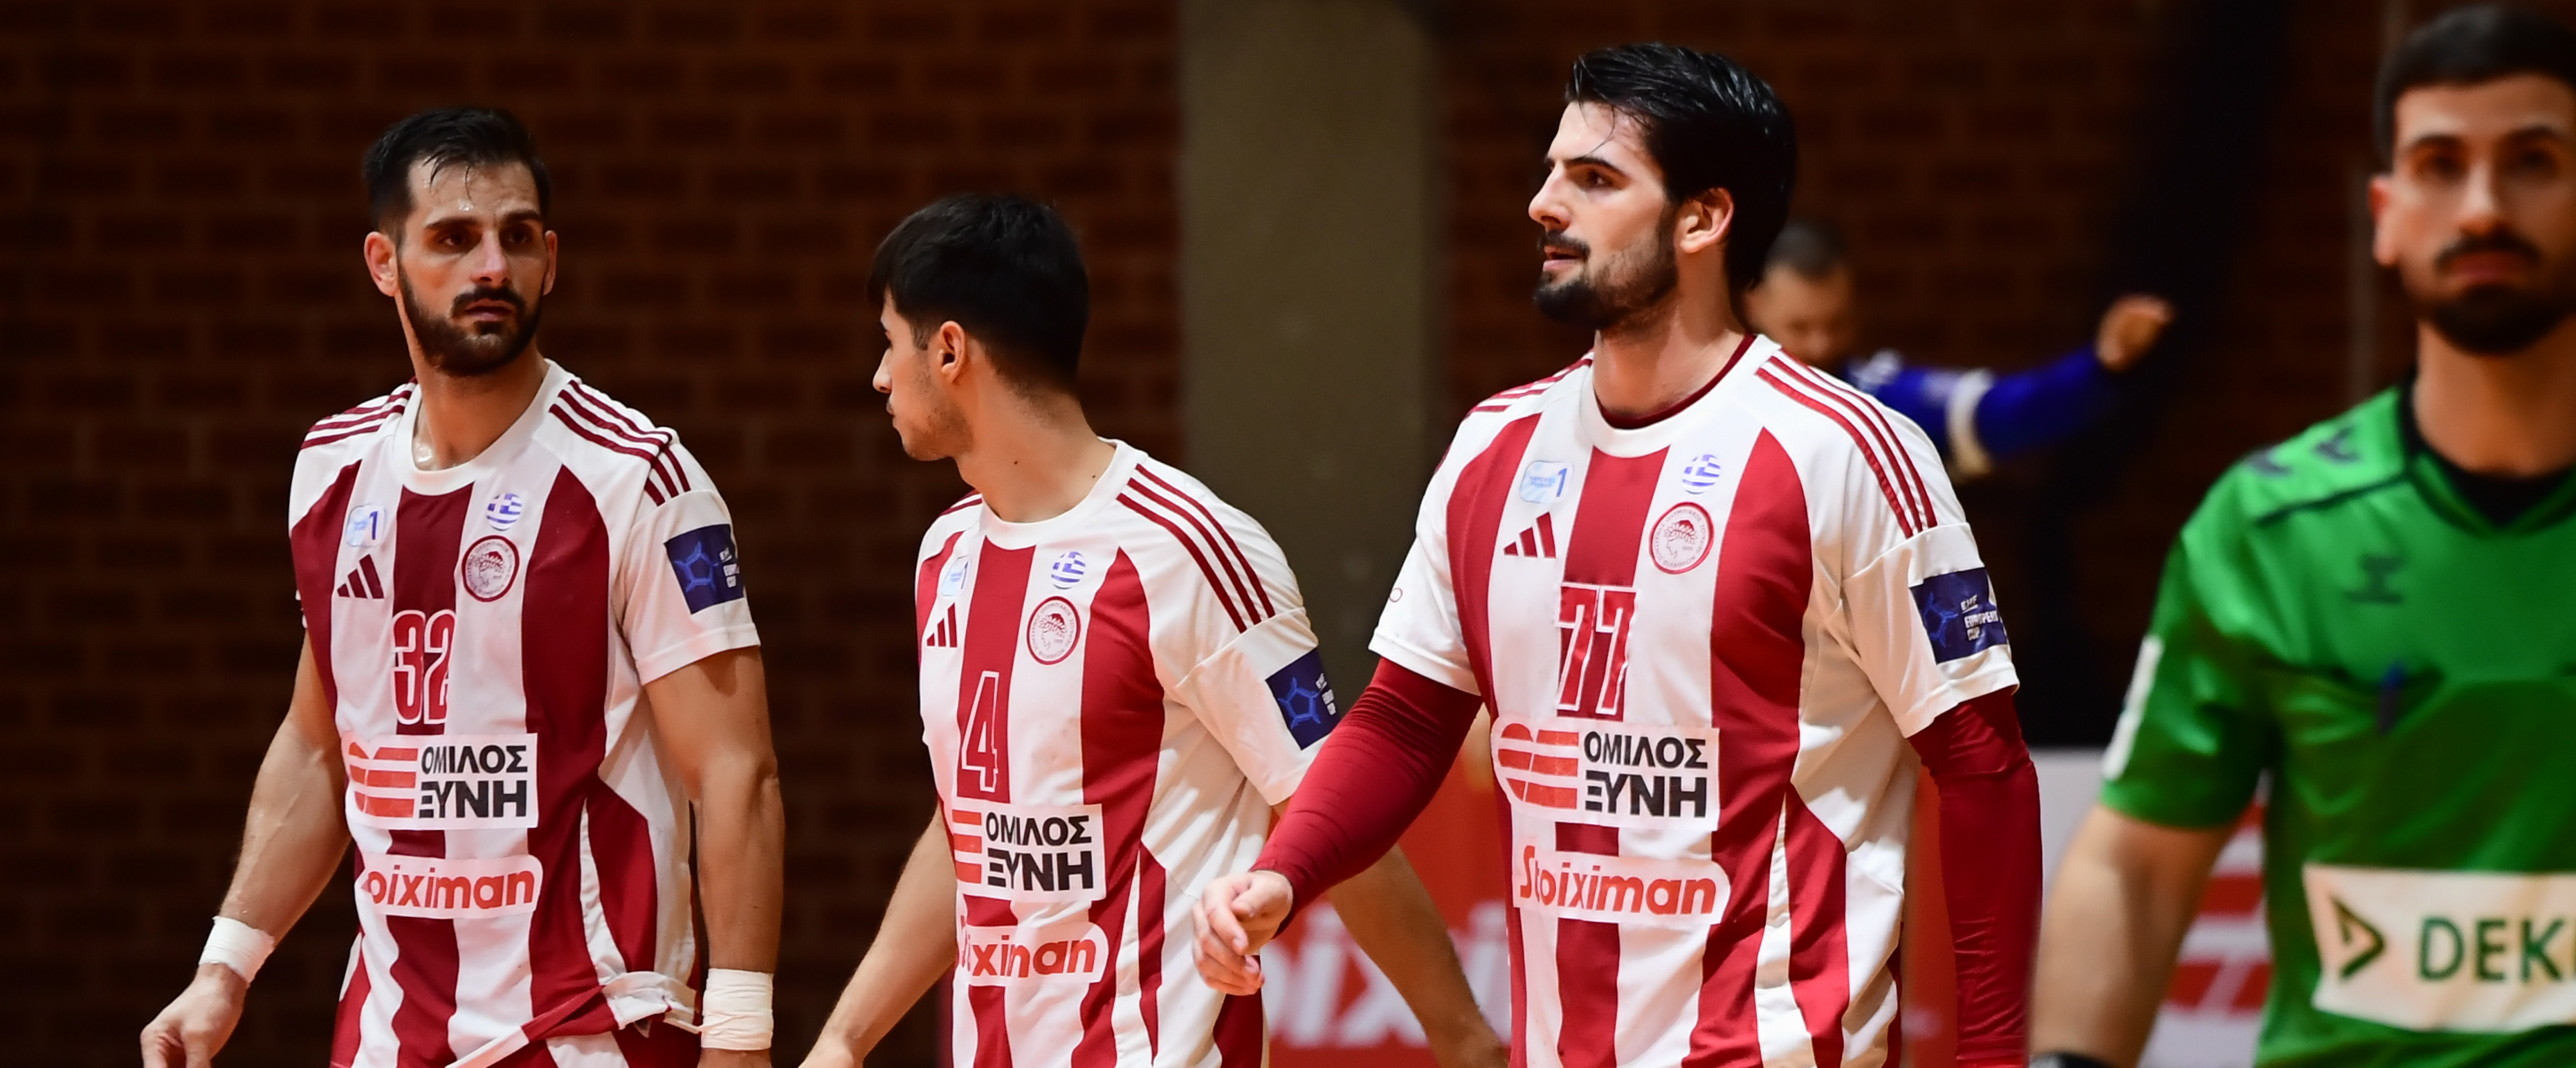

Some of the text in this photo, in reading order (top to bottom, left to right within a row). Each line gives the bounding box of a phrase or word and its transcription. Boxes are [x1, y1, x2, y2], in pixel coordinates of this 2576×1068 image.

[1557, 468, 1567, 497] 1
[369, 511, 378, 540] 1
[1960, 595, 1977, 610] EHF
[391, 609, 457, 725] 32
[1555, 581, 1638, 715] 77
[962, 671, 999, 793] 4
[1584, 731, 1708, 769] ΟΜΙΛΟΣ
[421, 745, 528, 775] ΟΜΙΛΟΣ
[419, 780, 527, 818] ΞΥΝΗ
[1584, 770, 1708, 817] ΞΥΝΗ
[986, 812, 1092, 846] ΟΜΙΛΟΣ
[361, 865, 535, 909] oiximan
[987, 848, 1093, 891] ΞΥΝΗ
[1520, 845, 1717, 915] Stoiximan
[2418, 917, 2576, 982] DEK
